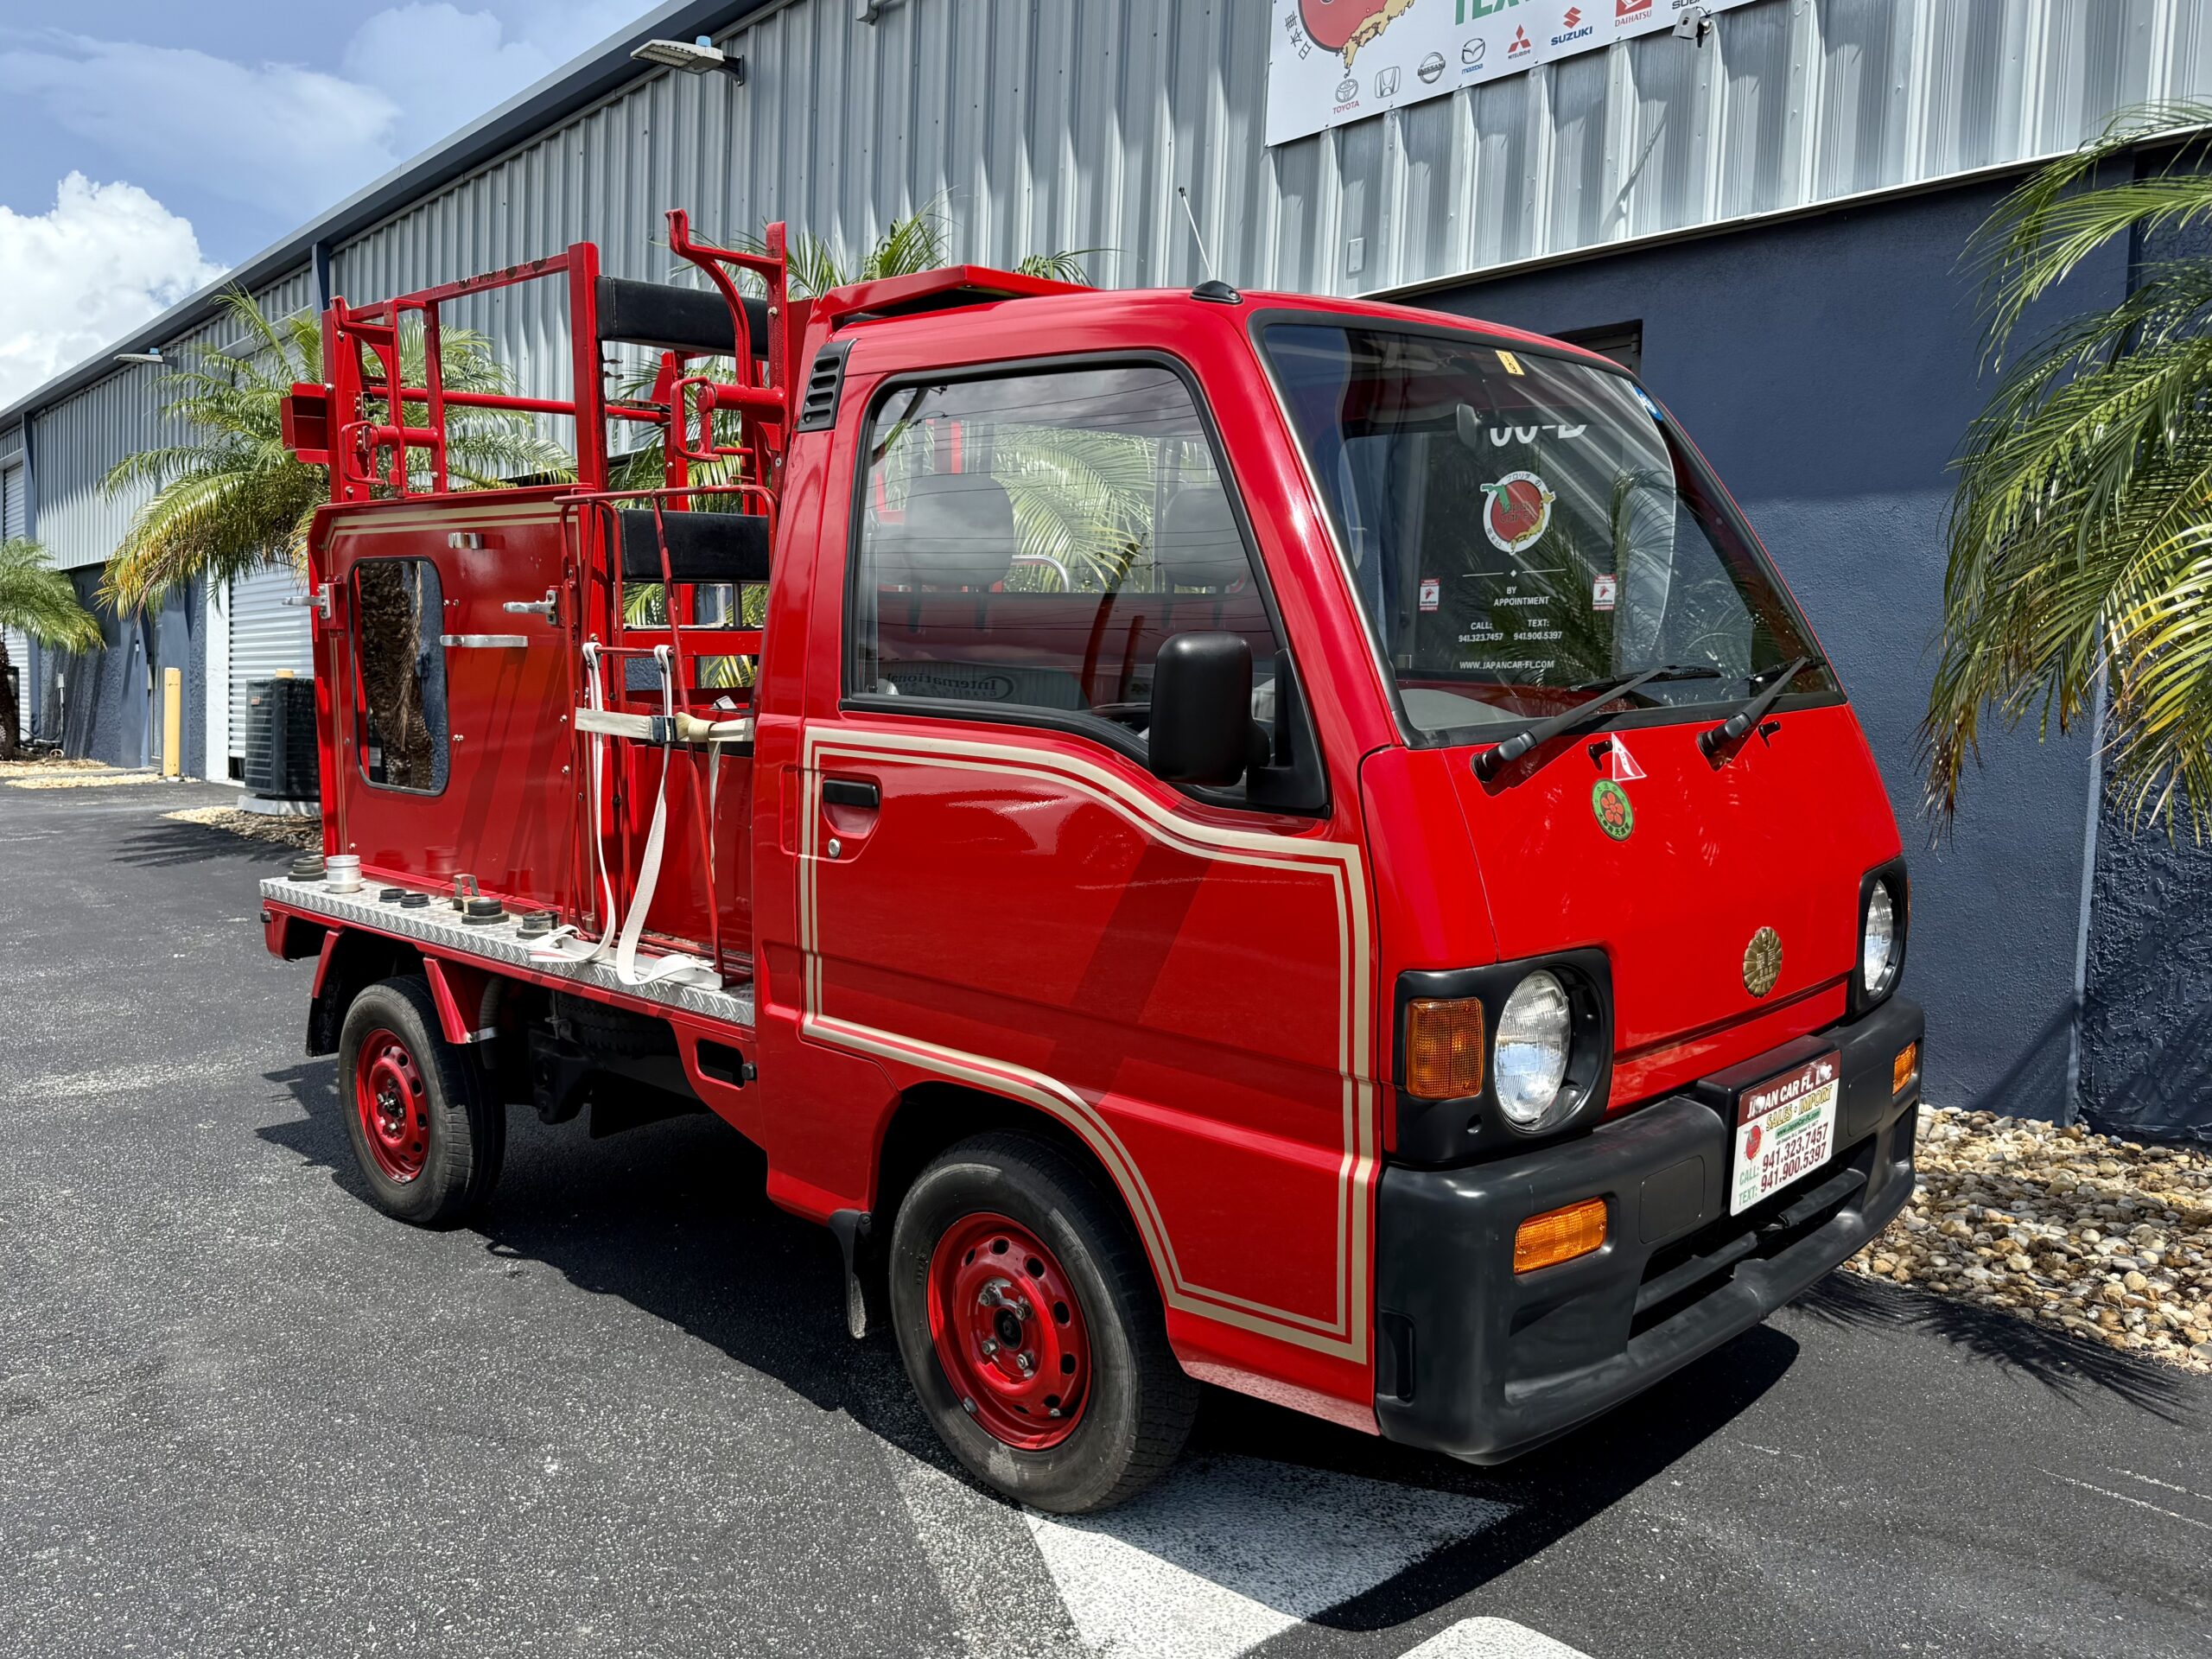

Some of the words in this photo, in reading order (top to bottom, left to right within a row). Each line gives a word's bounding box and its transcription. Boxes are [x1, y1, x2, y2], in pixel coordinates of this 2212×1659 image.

[1614, 10, 1652, 28] DAIHATSU
[1550, 26, 1593, 46] SUZUKI
[1420, 62, 1444, 75] NISSAN
[1332, 100, 1360, 115] TOYOTA
[1506, 586, 1517, 594] BY
[1493, 596, 1550, 607] APPOINTMENT
[1471, 621, 1492, 630] CALL:
[1528, 619, 1550, 627] TEXT:
[1458, 632, 1503, 643] 941.323.7457
[1513, 631, 1563, 640] 941.900.5397
[1459, 660, 1555, 670] WWW.JAPANCAR-FL.COM
[1780, 1080, 1800, 1103] CAR
[1766, 1103, 1793, 1132] SALES
[1798, 1084, 1833, 1116] IMPORT
[1739, 1166, 1759, 1186] CALL:
[1763, 1122, 1828, 1173] 941.323.7457
[1738, 1185, 1758, 1206] TEXT:
[1761, 1141, 1827, 1192] 941.900.5397
